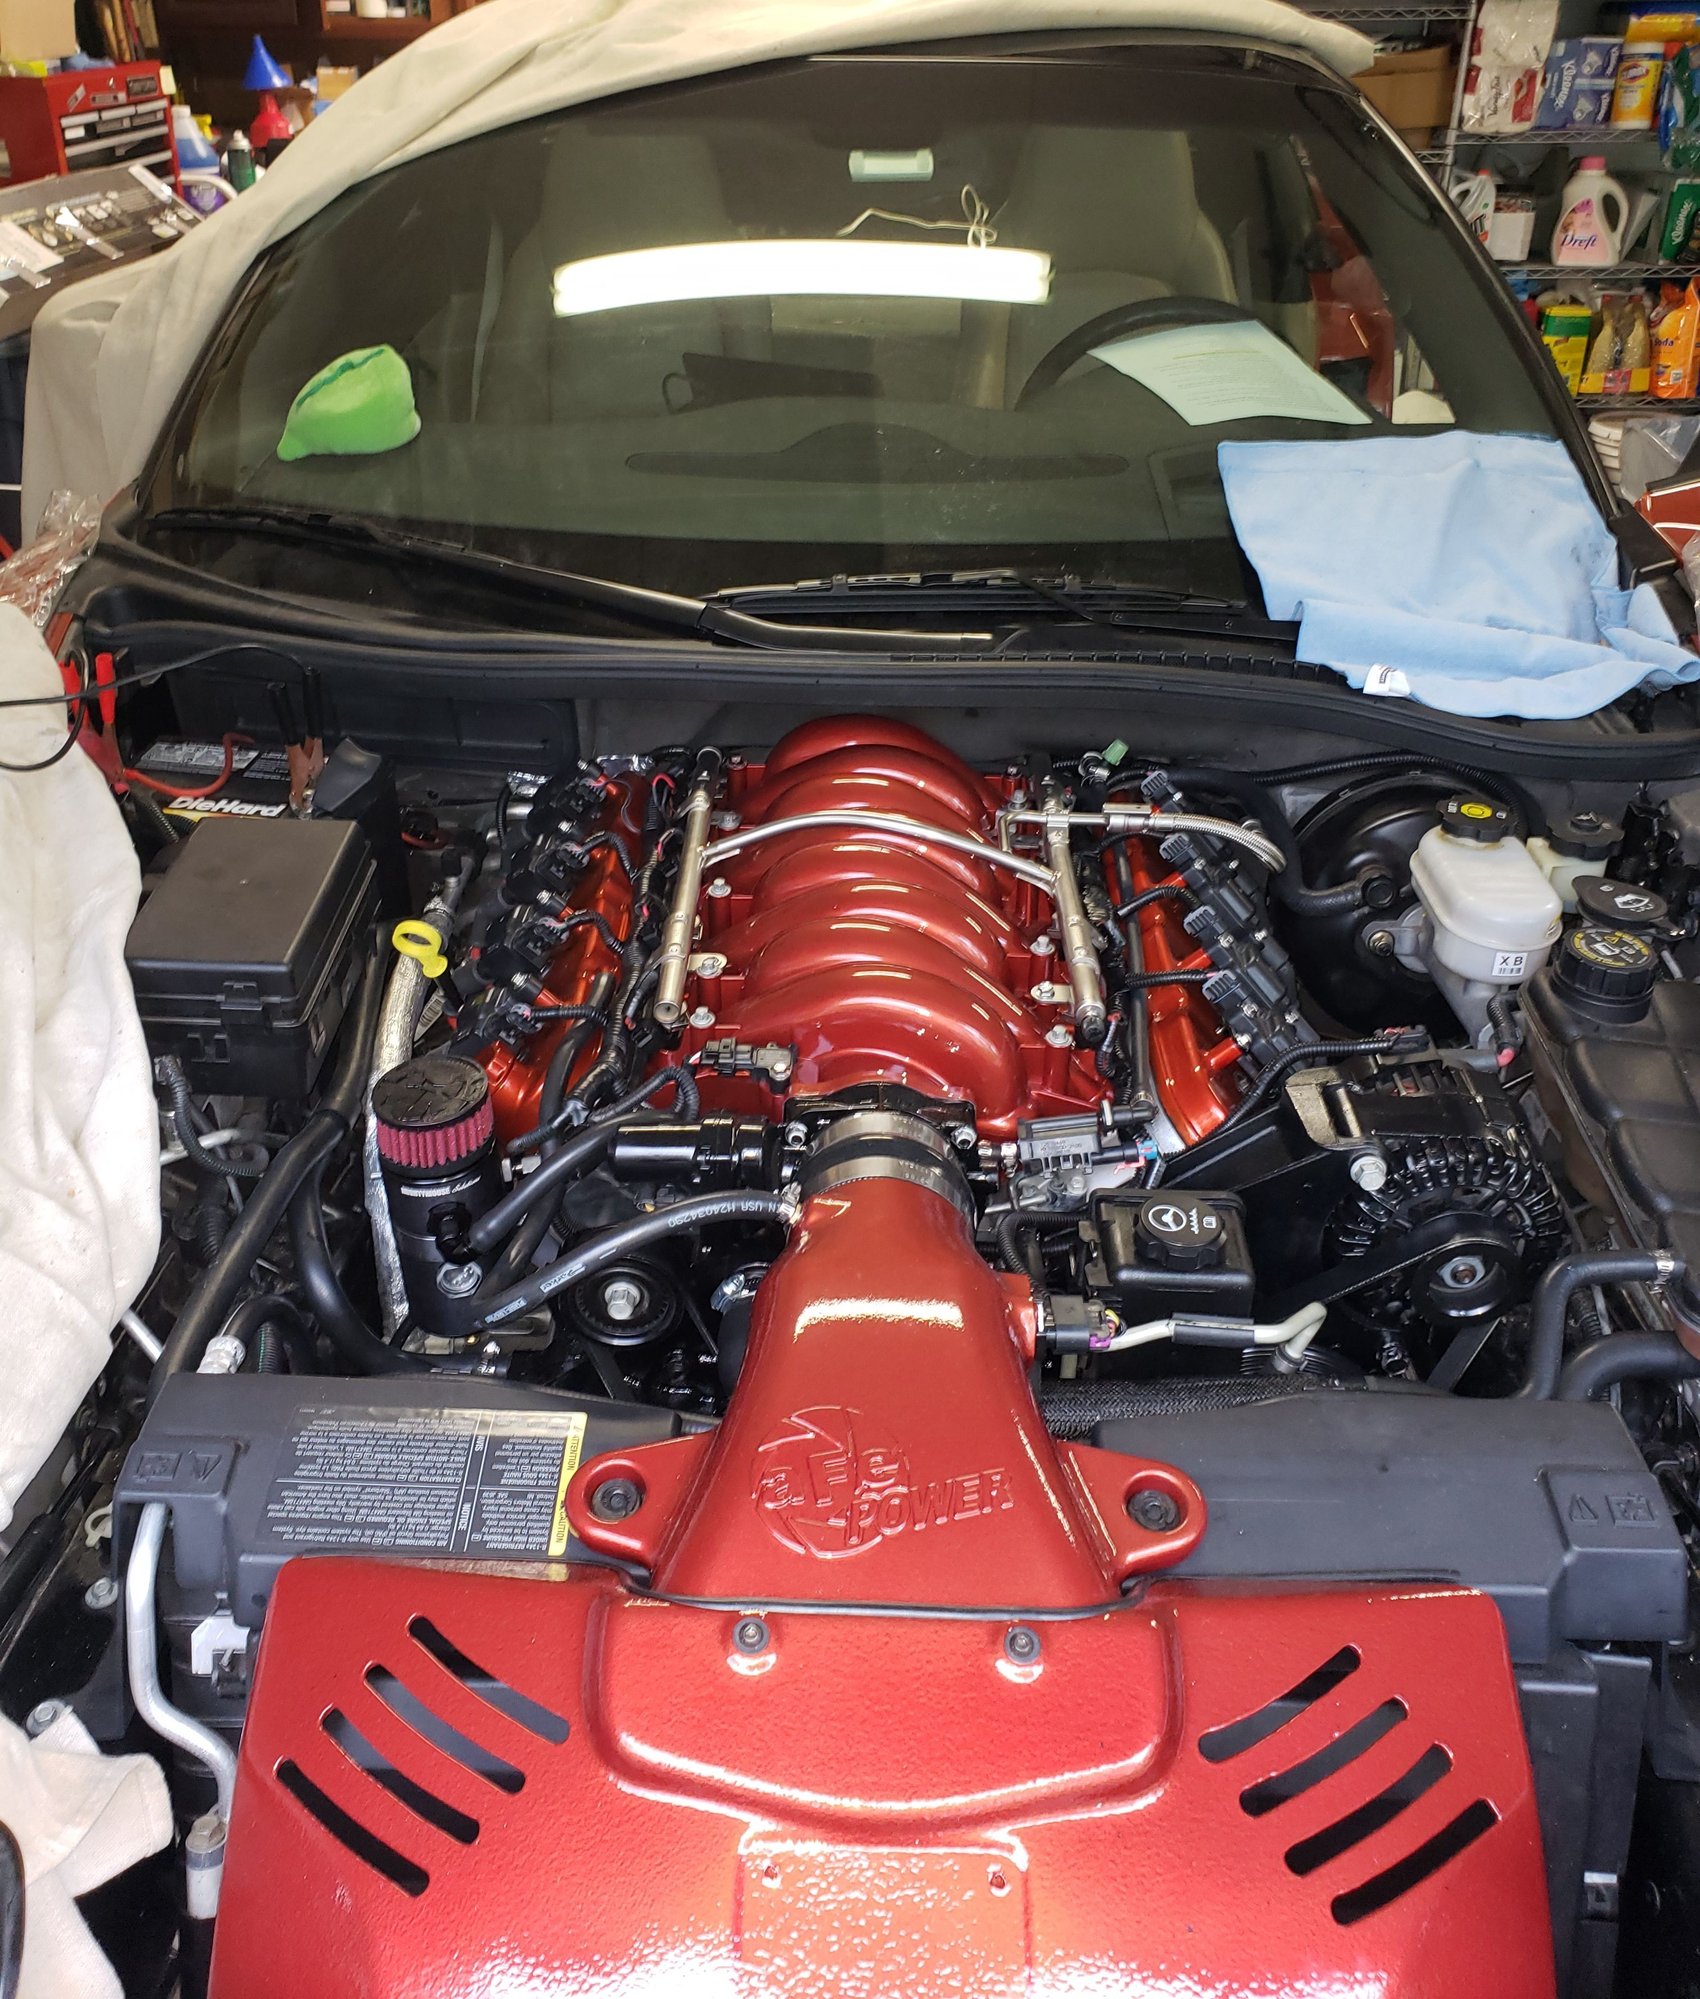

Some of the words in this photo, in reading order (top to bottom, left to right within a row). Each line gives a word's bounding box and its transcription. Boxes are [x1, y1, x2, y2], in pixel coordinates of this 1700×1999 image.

[1560, 233, 1598, 250] Dreft
[168, 796, 287, 817] DieHard
[740, 1199, 763, 1213] USA
[843, 1466, 1015, 1545] POWER
[458, 1502, 472, 1531] NOTICE
